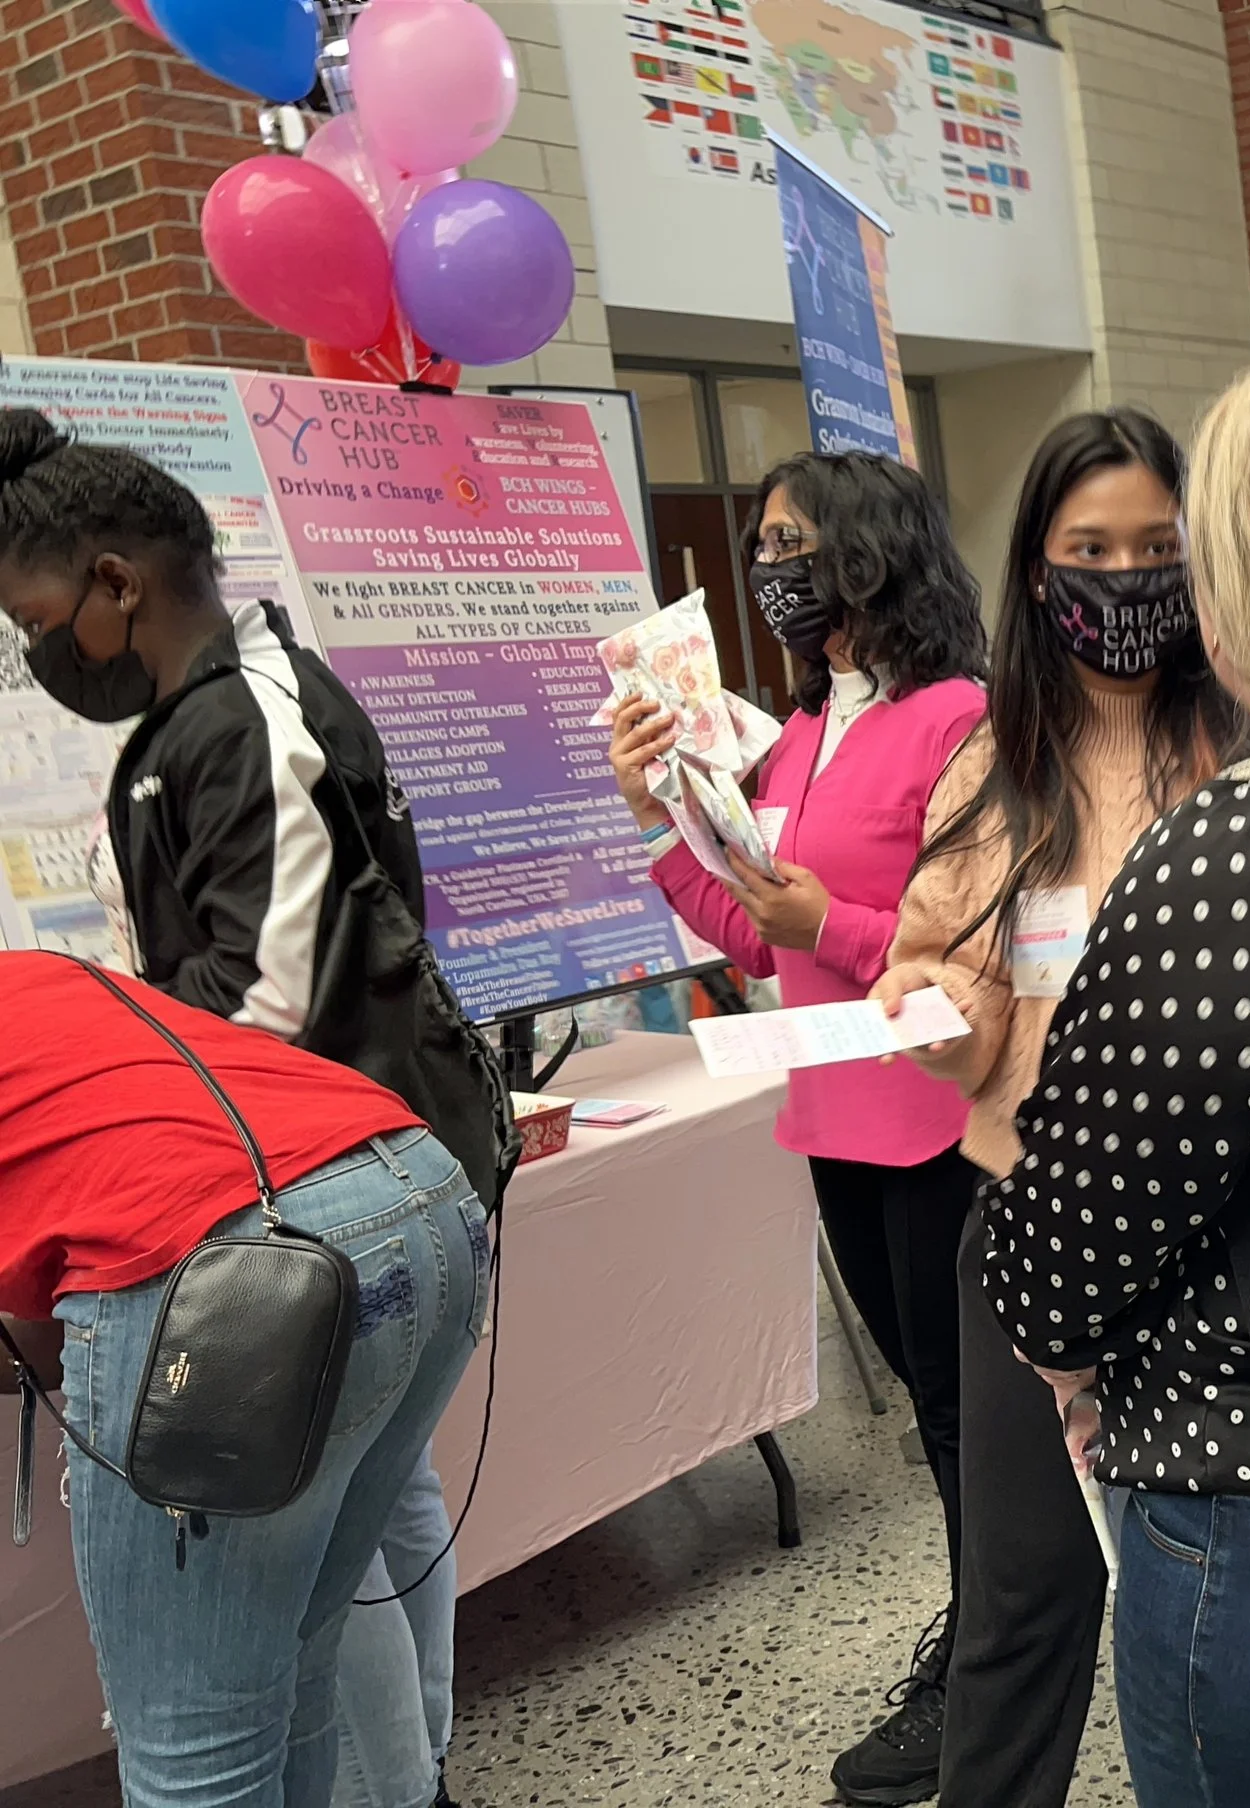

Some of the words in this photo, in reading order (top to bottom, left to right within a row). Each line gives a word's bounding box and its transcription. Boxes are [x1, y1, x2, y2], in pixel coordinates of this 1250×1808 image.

[750, 161, 777, 186] As
[319, 389, 420, 418] BREAST
[331, 418, 442, 446] CANCER
[339, 446, 400, 471] HUB
[277, 476, 357, 502] Driving
[361, 484, 372, 499] a
[377, 481, 445, 504] Change
[500, 477, 534, 493] BCH
[534, 478, 586, 495] WINGS
[506, 499, 568, 515] CANCER
[571, 500, 611, 516] HUBS
[303, 522, 419, 544] Grassroots
[424, 525, 535, 545] Sustainable
[538, 528, 623, 546] Solutions
[372, 548, 444, 571] Saving
[446, 549, 499, 567] Lives
[504, 549, 580, 571] Globally
[313, 581, 341, 597] We
[345, 580, 386, 601] fight
[388, 581, 450, 597] BREAST
[454, 580, 517, 596] CANCER
[519, 580, 535, 595] in
[537, 580, 600, 596] WOMEN,
[603, 580, 638, 595] MEN,
[333, 605, 346, 620] &
[351, 603, 375, 620] All
[378, 603, 460, 619] GENDERS.
[461, 602, 487, 617] We
[491, 602, 530, 616] stand
[532, 600, 590, 617] together
[594, 599, 641, 616] against
[416, 623, 446, 640] ALL
[448, 621, 497, 639] TYPES
[500, 621, 521, 636] OF
[525, 619, 592, 636] CANCERS
[1103, 611, 1189, 653] CANC
[403, 647, 481, 668] Mission
[500, 643, 559, 663] Global
[561, 643, 601, 664] Imp
[1103, 647, 1157, 674] HUB
[360, 673, 436, 692] AWARENESS
[539, 665, 602, 680] EDUCATION
[365, 693, 407, 709] EARLY
[407, 689, 477, 707] DETECTION
[544, 682, 601, 696] RESEARCH
[371, 709, 449, 727] COMMUNITY
[451, 703, 529, 722] OUTREACHES
[556, 715, 594, 730] PREVE
[449, 723, 491, 740] CAMPS
[384, 746, 443, 764] VILLAGES
[445, 740, 507, 758] ADOPTION
[568, 749, 604, 764] COVID
[466, 760, 489, 776] AID
[573, 765, 616, 780] LEADER
[402, 781, 452, 801] UPPORT
[452, 776, 503, 795] GROUPS
[446, 898, 646, 949] #TogetherWeSaveLives
[479, 992, 549, 1016] #KnowYourBody
